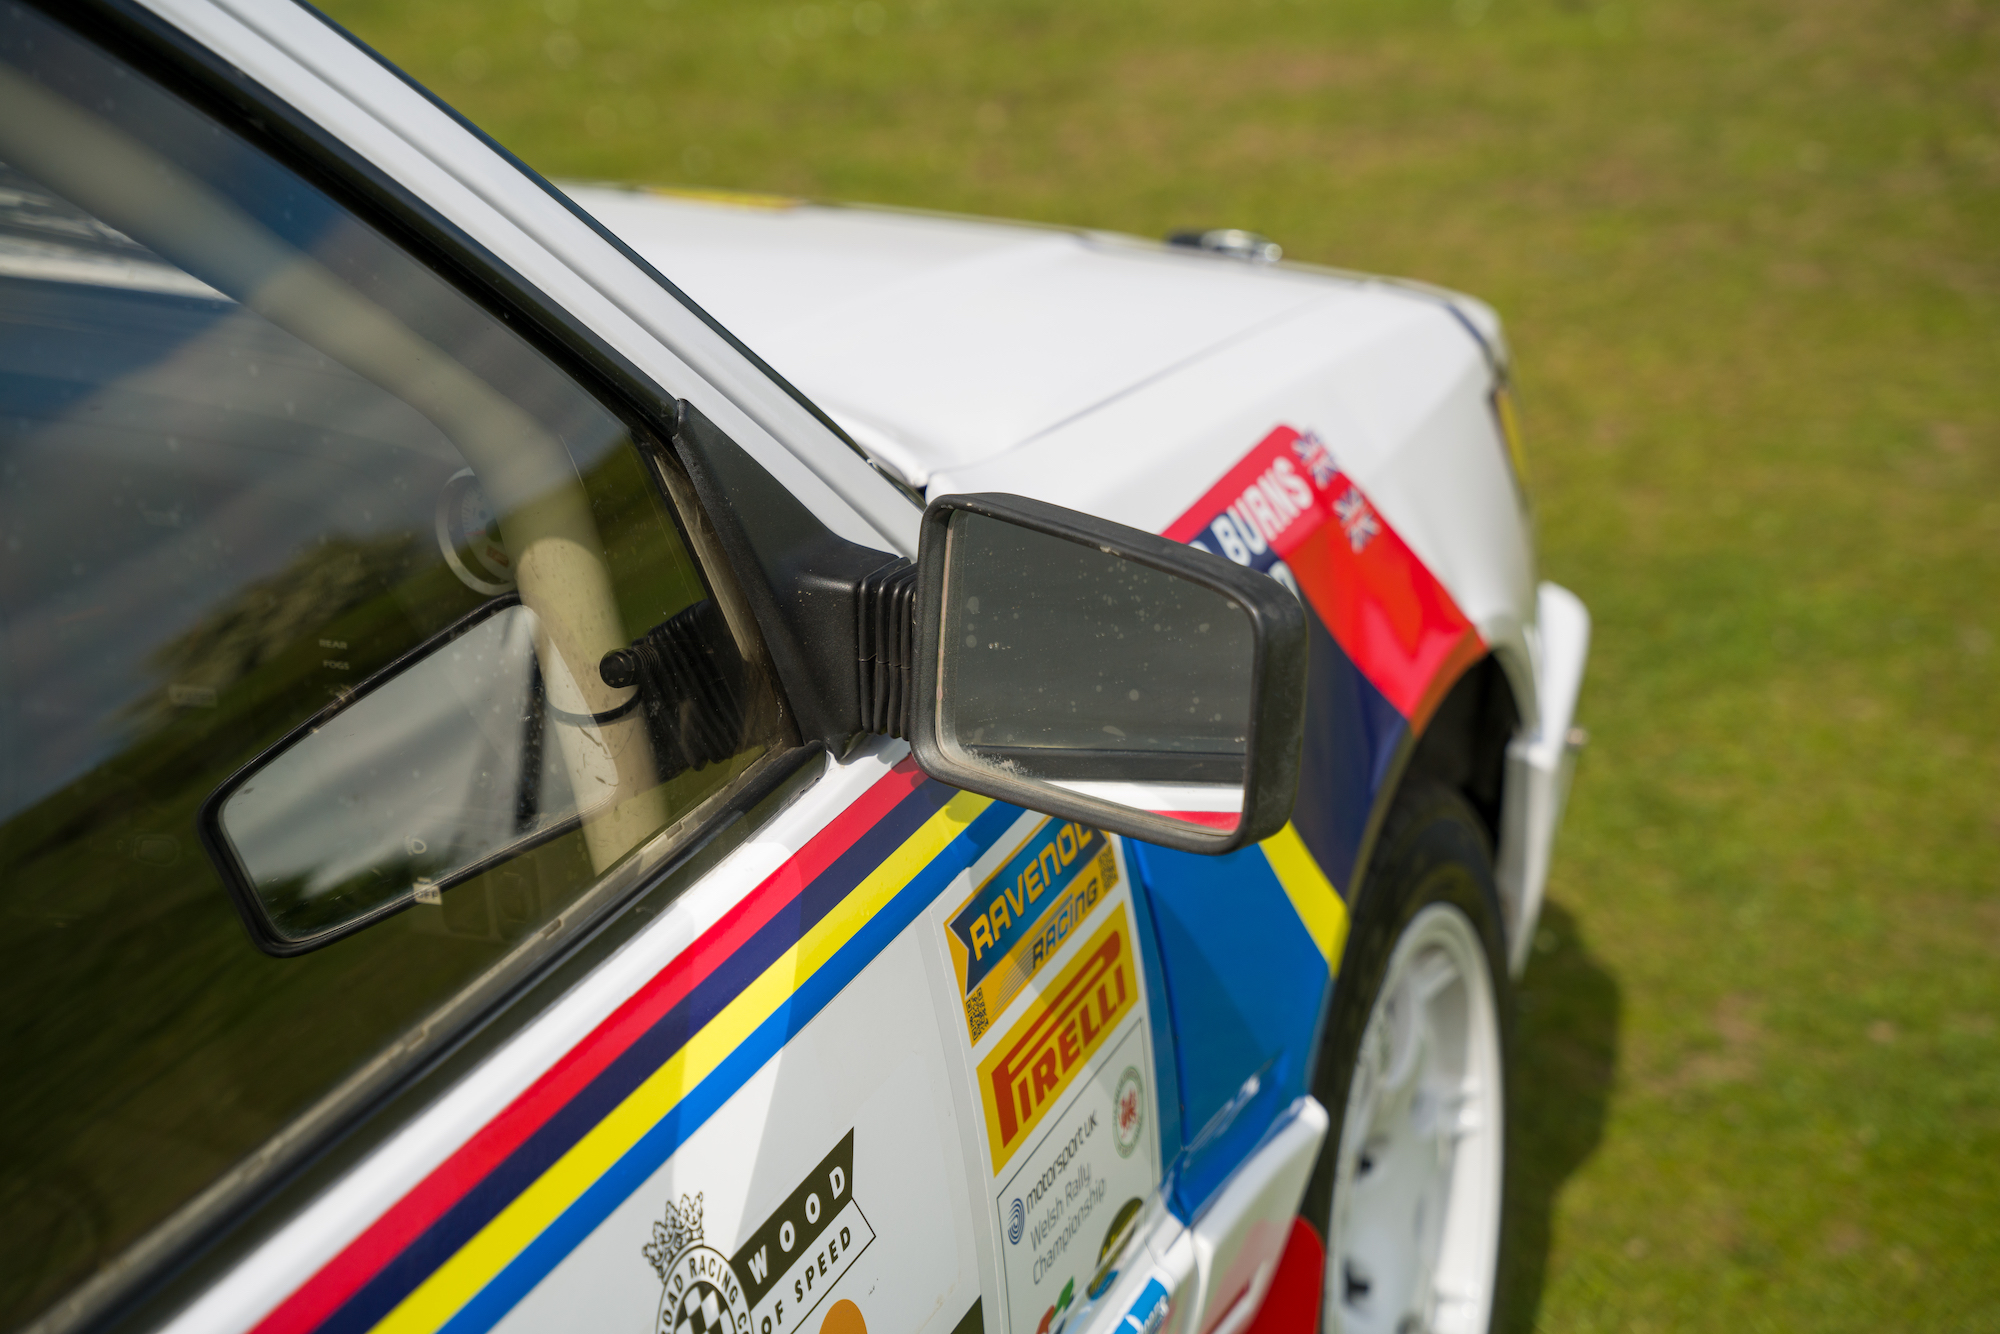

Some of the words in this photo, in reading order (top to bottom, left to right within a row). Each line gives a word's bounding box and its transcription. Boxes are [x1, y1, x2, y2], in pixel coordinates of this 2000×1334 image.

[1210, 456, 1314, 567] BURNS
[319, 639, 348, 650] REAR
[323, 659, 350, 670] FOGS
[968, 822, 1093, 961] RAVENOL
[1031, 876, 1098, 970] RACING
[991, 930, 1127, 1149] PIRELLI
[1025, 1126, 1085, 1215] motorsport
[1030, 1196, 1065, 1251] Welsh
[1064, 1161, 1092, 1202] Rally
[747, 1166, 846, 1285] WOOD
[1033, 1178, 1107, 1285] Championship
[660, 1274, 684, 1334] OAD
[688, 1255, 739, 1307] RACING
[761, 1298, 784, 1334] OF
[794, 1226, 852, 1303] SPEED
